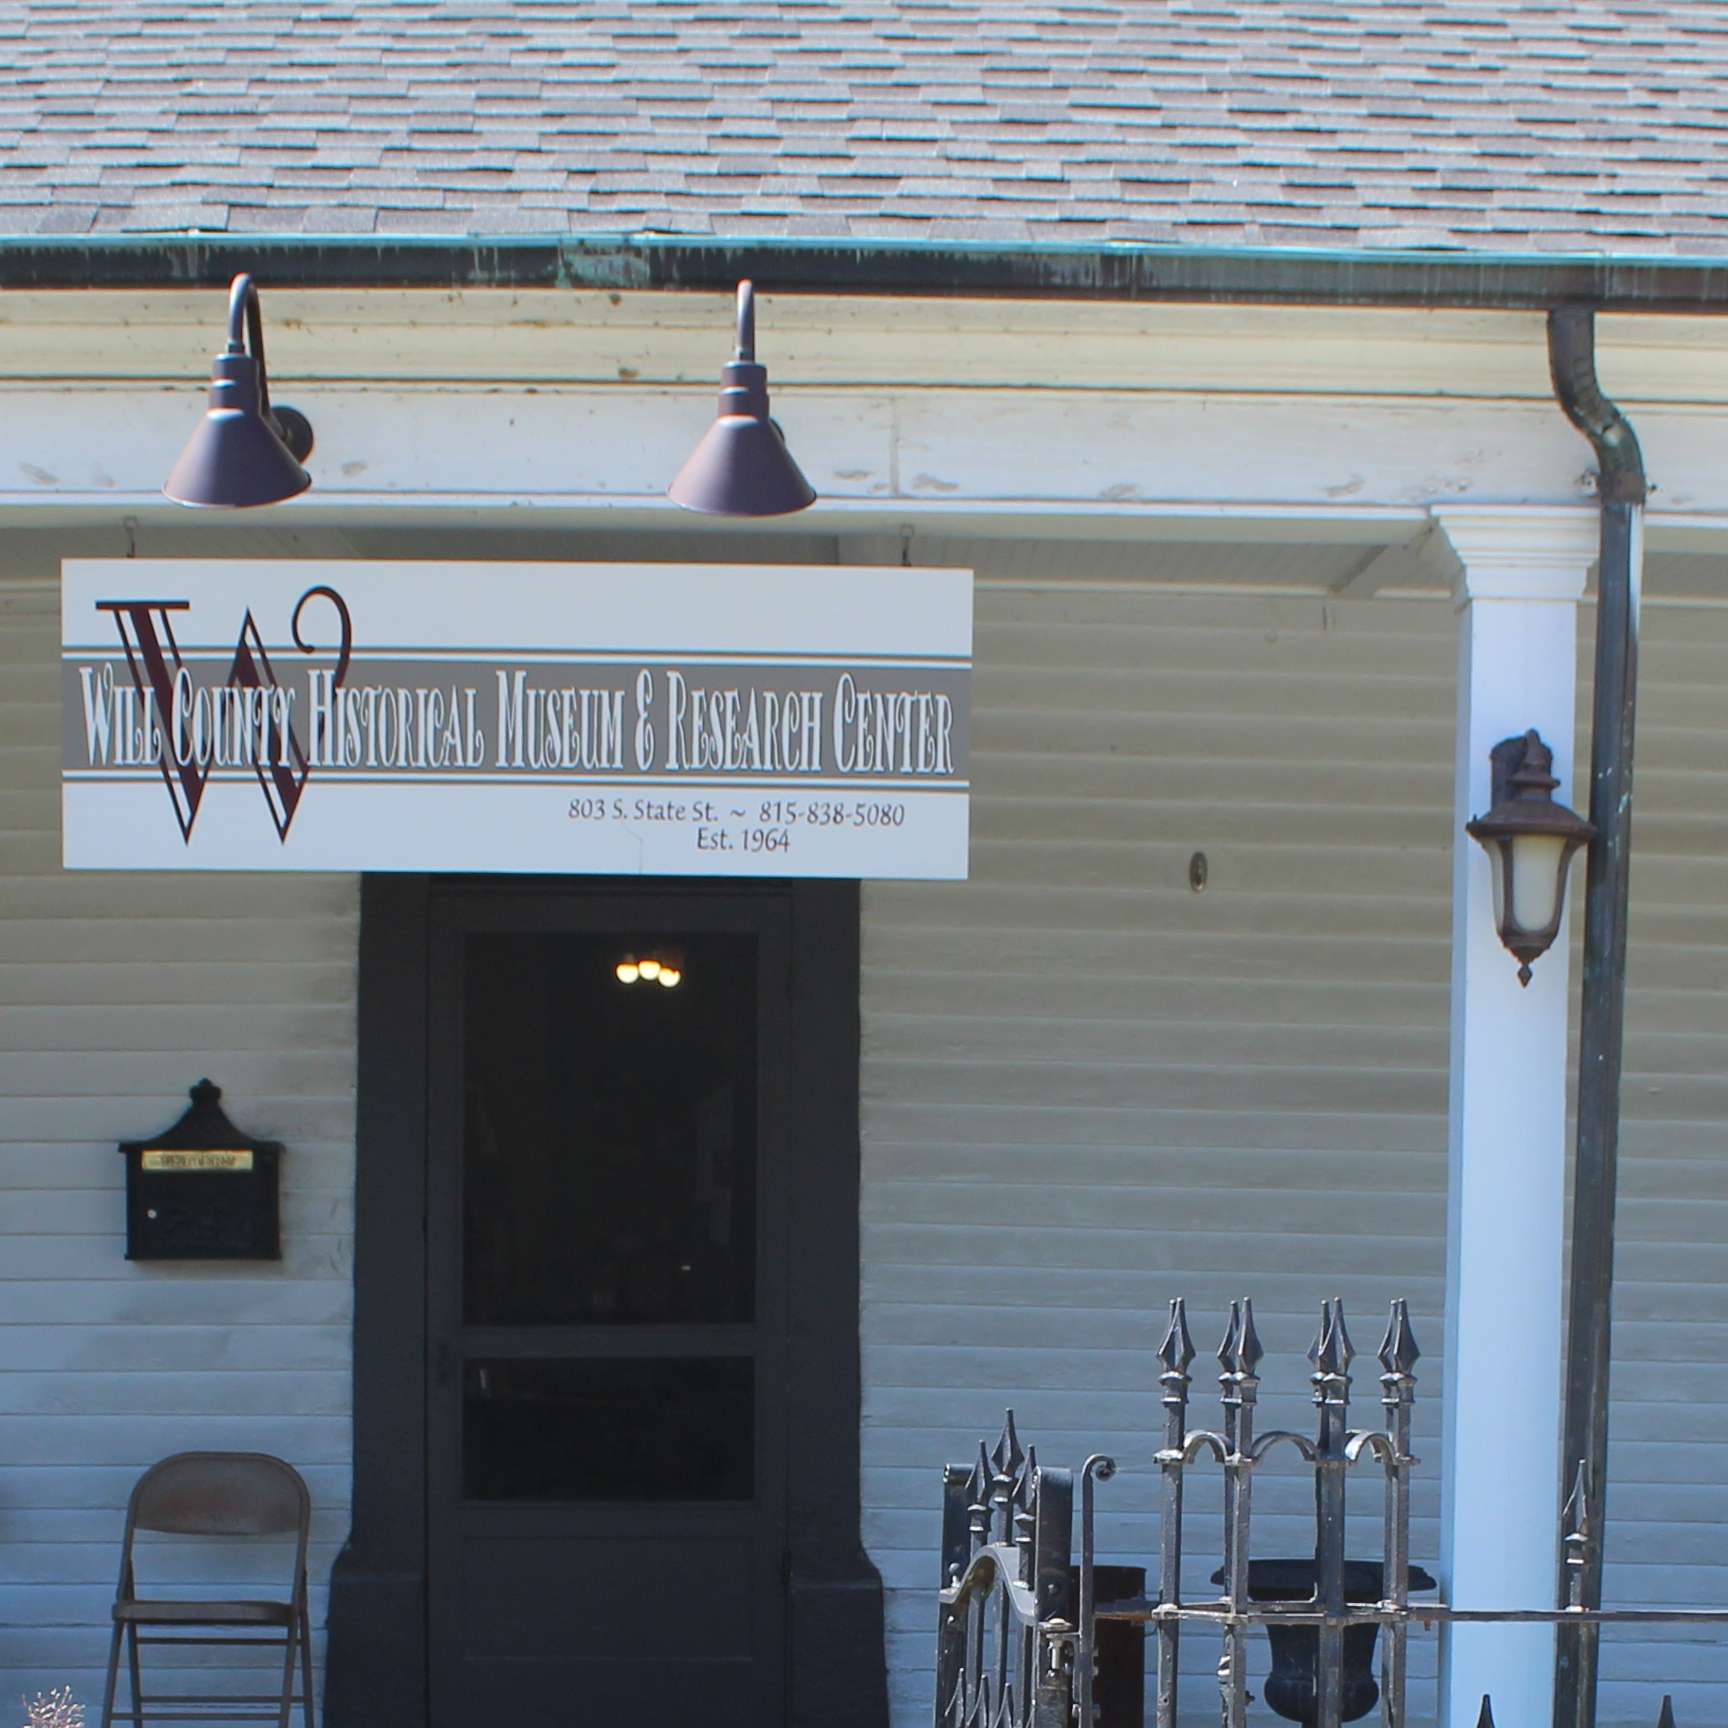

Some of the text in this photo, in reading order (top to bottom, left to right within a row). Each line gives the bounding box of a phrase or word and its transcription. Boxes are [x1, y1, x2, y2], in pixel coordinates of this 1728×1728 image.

[79, 662, 955, 775] WILL COUNTY HISTORICAL MUSEUM & RESEARCH CENTER
[568, 798, 606, 821] 803
[612, 799, 629, 821] S.
[633, 800, 687, 822] State
[691, 801, 719, 823] St.
[758, 801, 906, 828] 815-838-5080
[696, 827, 791, 853] Est. 1964
